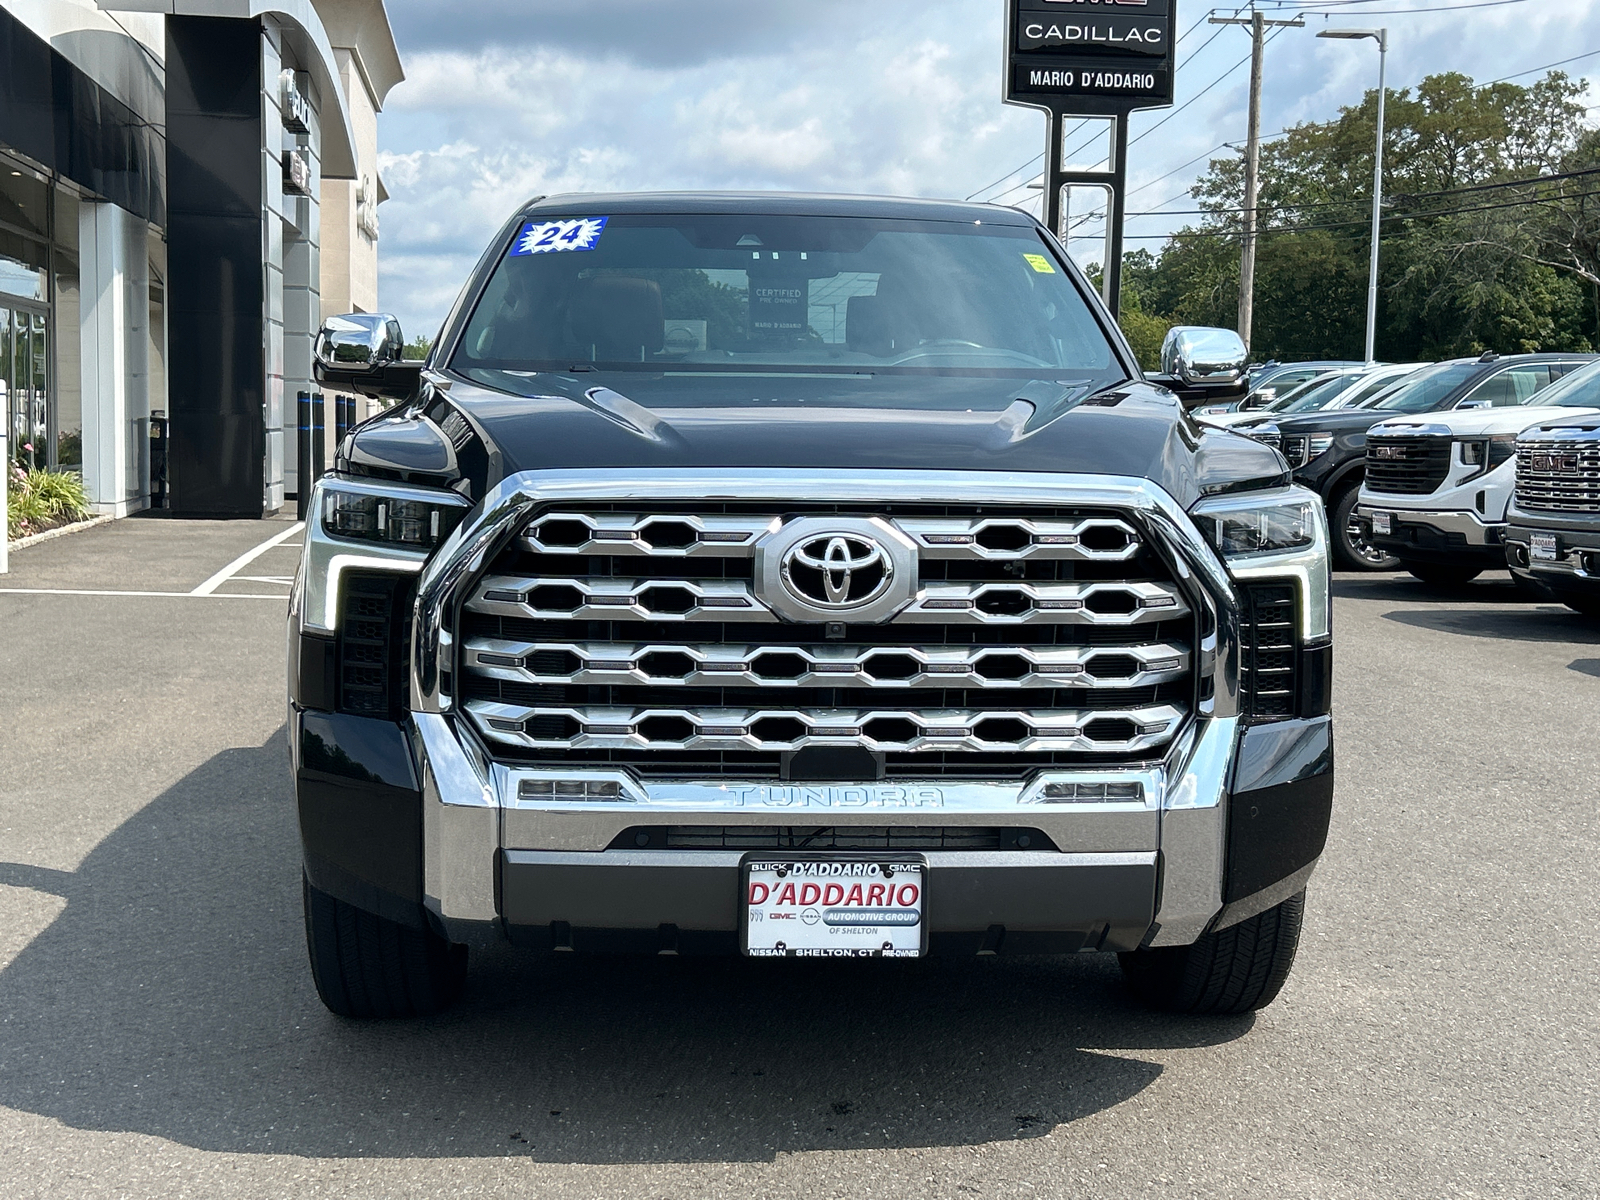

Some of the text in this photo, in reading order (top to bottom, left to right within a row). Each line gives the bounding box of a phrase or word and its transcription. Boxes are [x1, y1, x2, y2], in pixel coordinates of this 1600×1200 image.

[1025, 24, 1162, 43] CADILLAC
[1029, 70, 1155, 89] MARIO D'ADDARIO
[533, 224, 584, 247] 24
[755, 288, 802, 298] CERTIFIED
[1376, 446, 1407, 459] GMC
[1532, 456, 1578, 472] GMC
[721, 786, 945, 807] TUNDRA
[751, 862, 921, 877] BUICK D'ADDARIO GMC
[748, 881, 920, 907] D'ADDARIO
[769, 912, 797, 920] GMC
[827, 912, 884, 921] AUTOMOTIVE
[885, 913, 916, 921] GROUP
[829, 927, 879, 935] OF SHELTON
[749, 948, 787, 957] NISSAN
[795, 949, 856, 958] SHELTON,
[858, 949, 875, 957] CT
